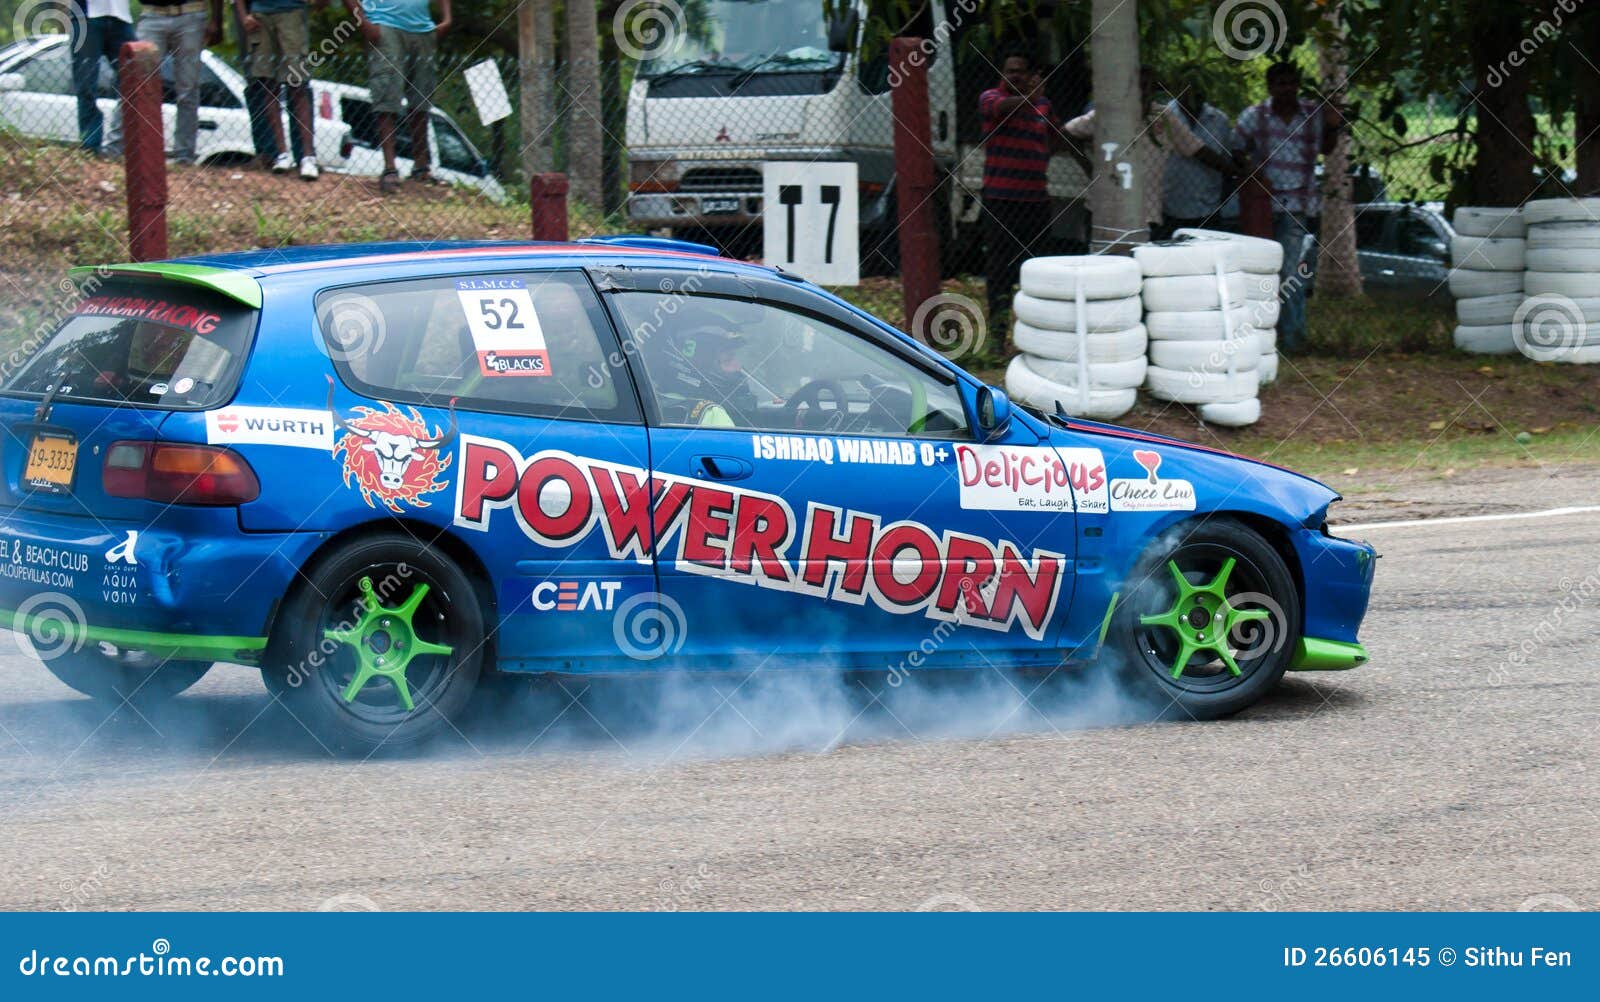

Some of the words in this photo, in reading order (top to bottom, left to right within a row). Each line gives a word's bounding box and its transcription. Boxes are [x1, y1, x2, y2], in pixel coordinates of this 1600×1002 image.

[146, 299, 221, 334] RACING
[480, 298, 525, 330] 52
[499, 358, 544, 370] BLACKS
[30, 447, 75, 471] 19-3333
[752, 435, 833, 464] ISHRAQ
[836, 438, 916, 465] WAHAB
[1018, 497, 1036, 507] Eat,
[1039, 498, 1068, 510] Laugh
[1080, 499, 1107, 510] Share
[1112, 481, 1158, 500] Choco
[458, 438, 792, 586] POWER
[801, 504, 1062, 637] HORN
[12, 539, 22, 565] &
[26, 545, 58, 567] BEACH
[60, 551, 88, 572] CLUB
[531, 581, 621, 611] CEAT
